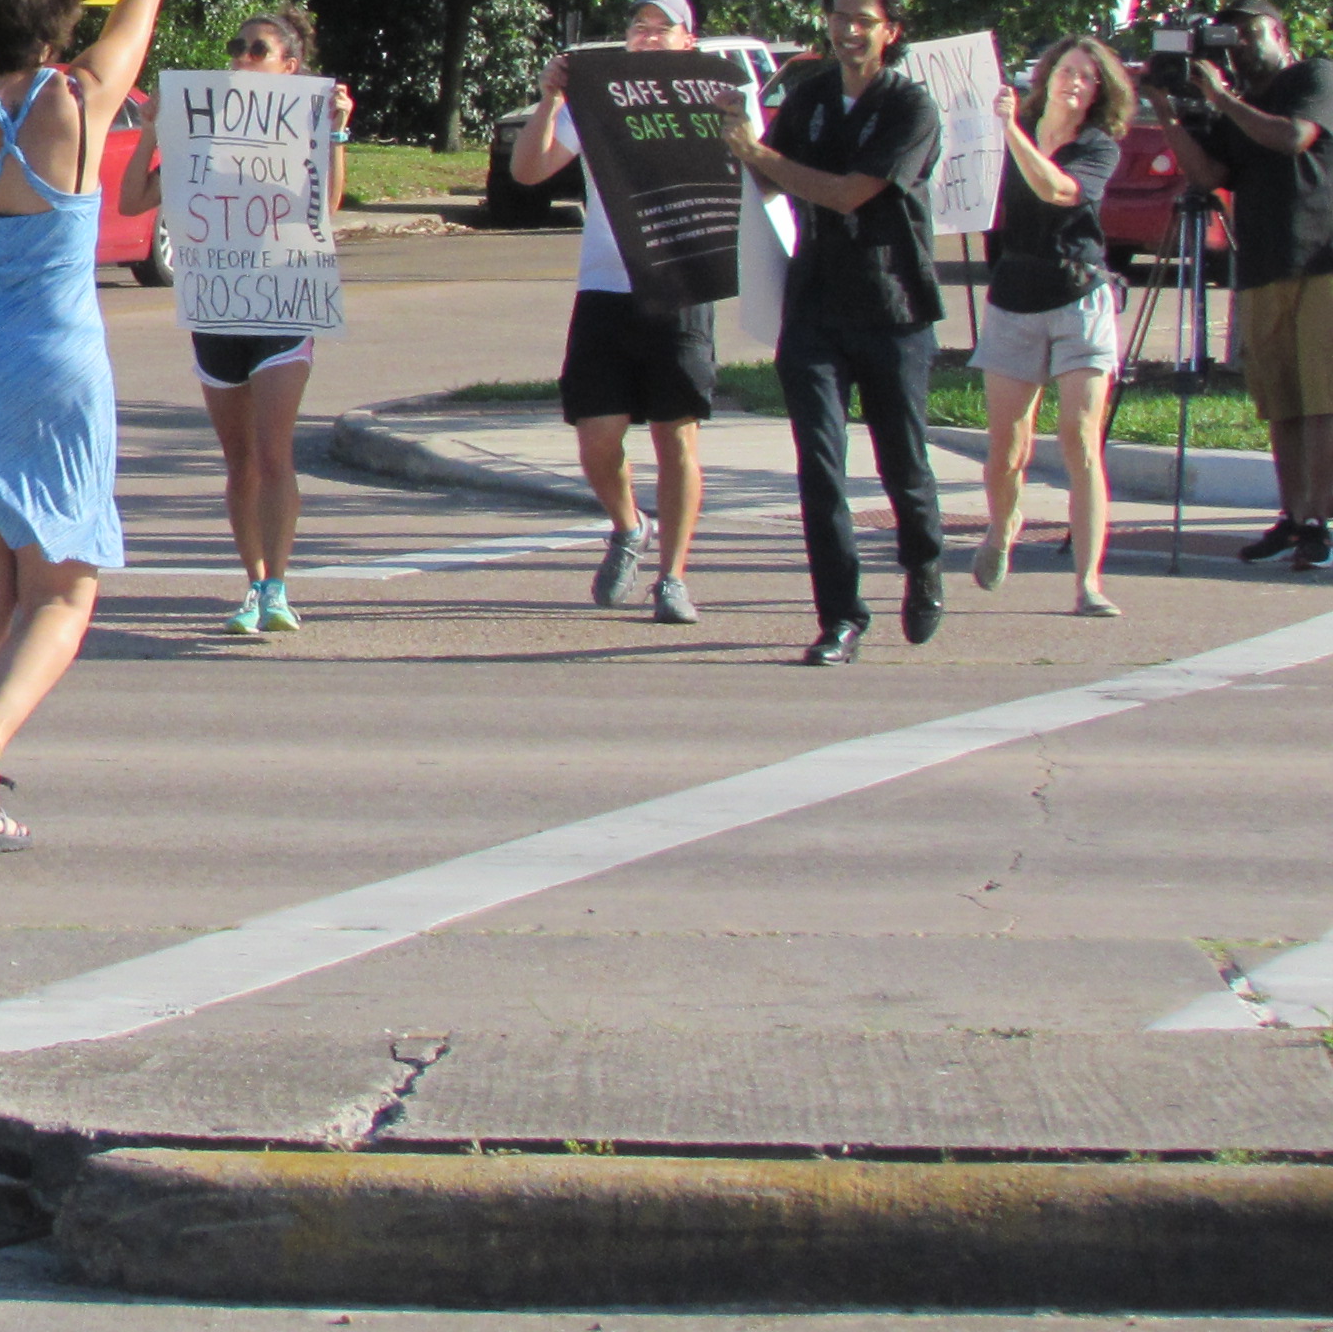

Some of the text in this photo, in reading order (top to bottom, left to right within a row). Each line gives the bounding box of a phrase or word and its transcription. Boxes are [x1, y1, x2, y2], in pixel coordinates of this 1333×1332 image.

[608, 79, 737, 107] SAFE STRE
[624, 113, 686, 140] SAFE
[188, 154, 289, 185] IF YOU
[186, 193, 291, 243] STOP
[179, 246, 337, 269] FOR PEOPLE IN THE
[182, 271, 343, 324] CROSSWALK
